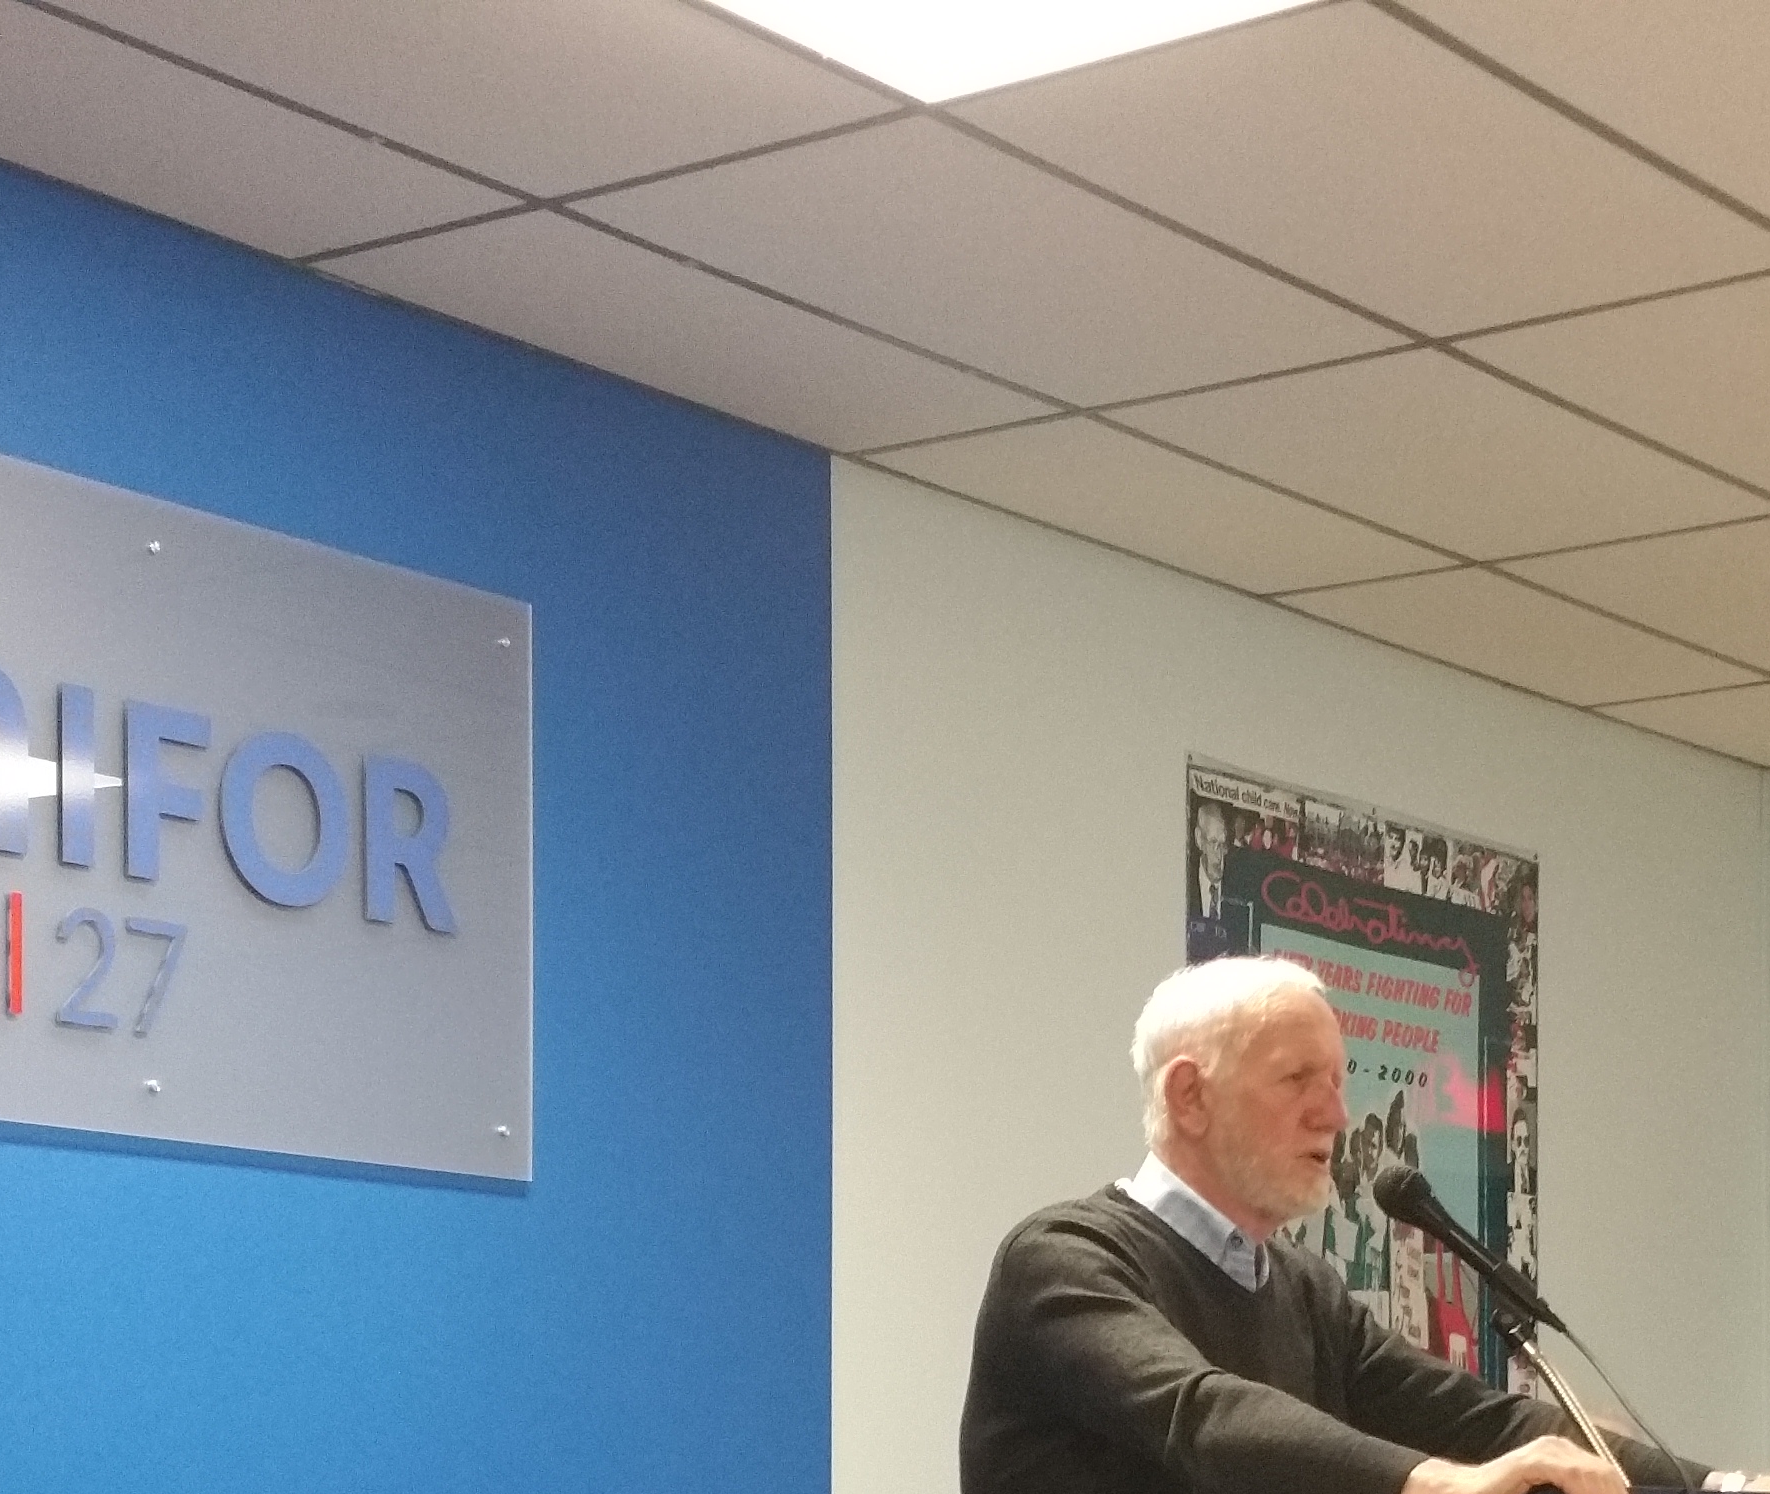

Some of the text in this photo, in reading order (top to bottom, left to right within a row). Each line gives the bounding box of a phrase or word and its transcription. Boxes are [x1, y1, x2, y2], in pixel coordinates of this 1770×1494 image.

[1193, 773, 1240, 801] National
[1241, 789, 1263, 807] child
[55, 906, 189, 1037] 27
[1317, 957, 1363, 994] YEARS
[1366, 970, 1441, 1011] FIGHTING
[1444, 987, 1473, 1018] FOR
[1381, 1018, 1440, 1054] PEOPLE
[1377, 1063, 1429, 1088] 2000
